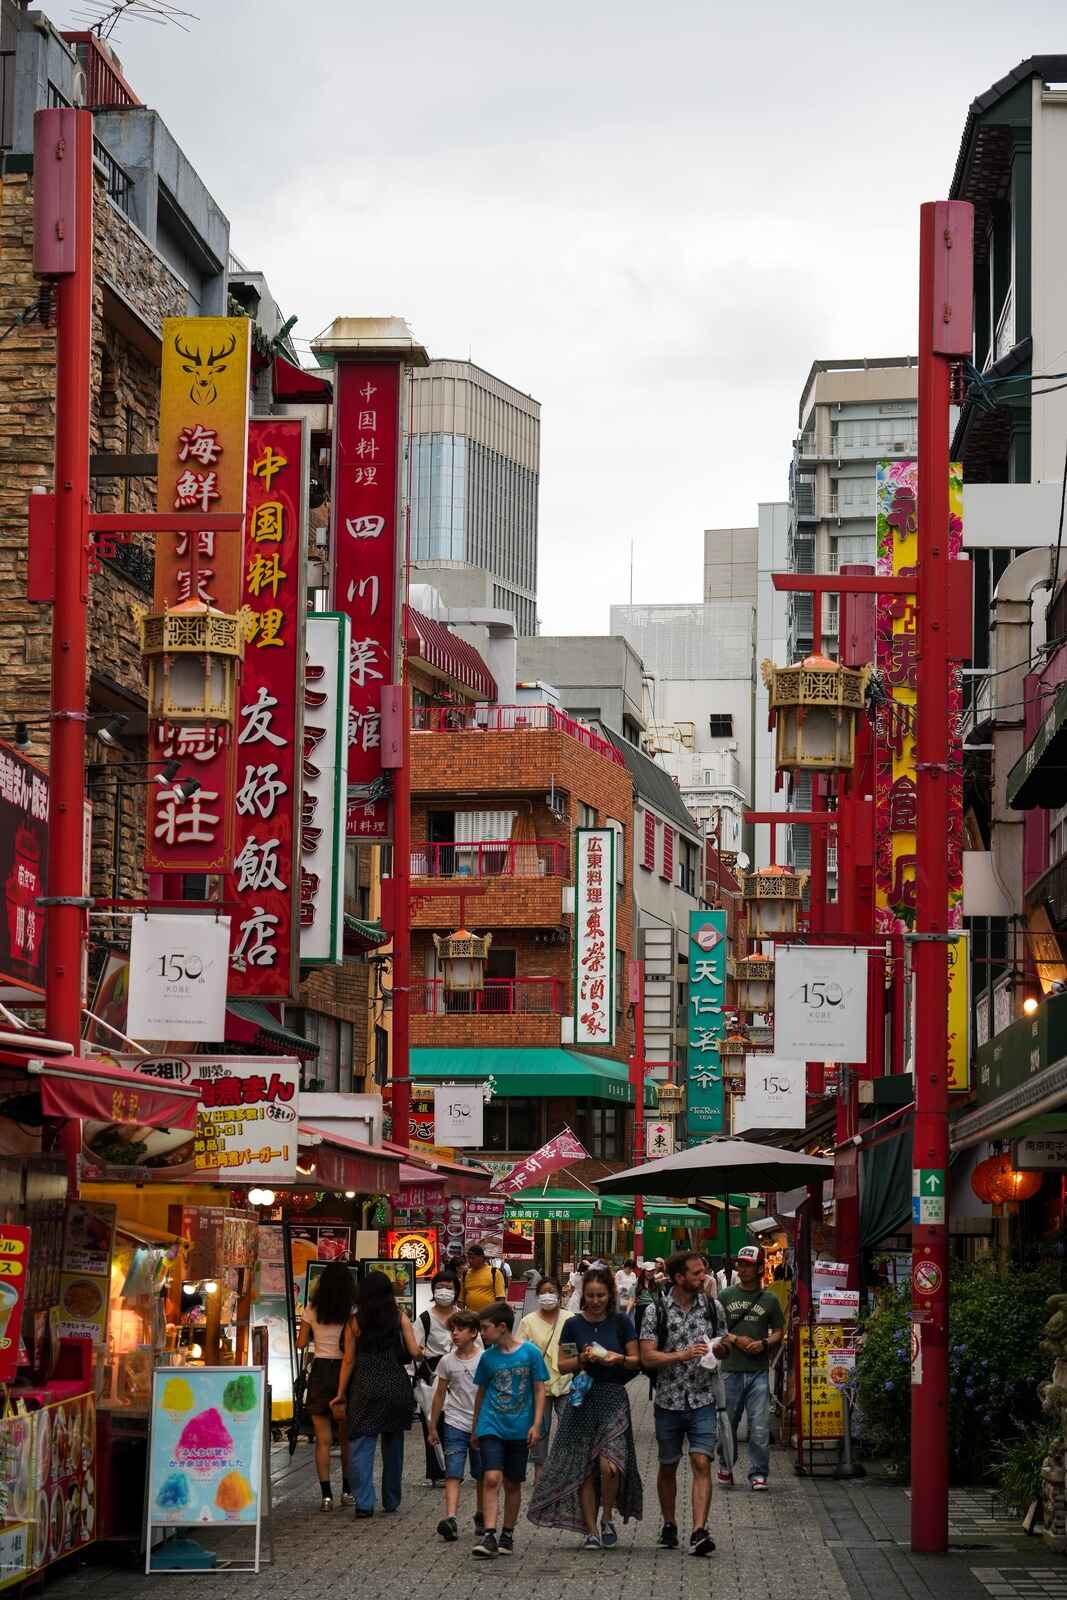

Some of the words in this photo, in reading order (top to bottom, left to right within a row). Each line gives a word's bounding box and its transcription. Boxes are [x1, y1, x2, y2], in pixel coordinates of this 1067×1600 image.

[353, 381, 380, 487] 中国料理
[245, 446, 288, 649] 中国料理
[232, 687, 288, 973] 友好飯店
[586, 836, 604, 903] 広東料理
[690, 960, 722, 1089] 天仁茗茶
